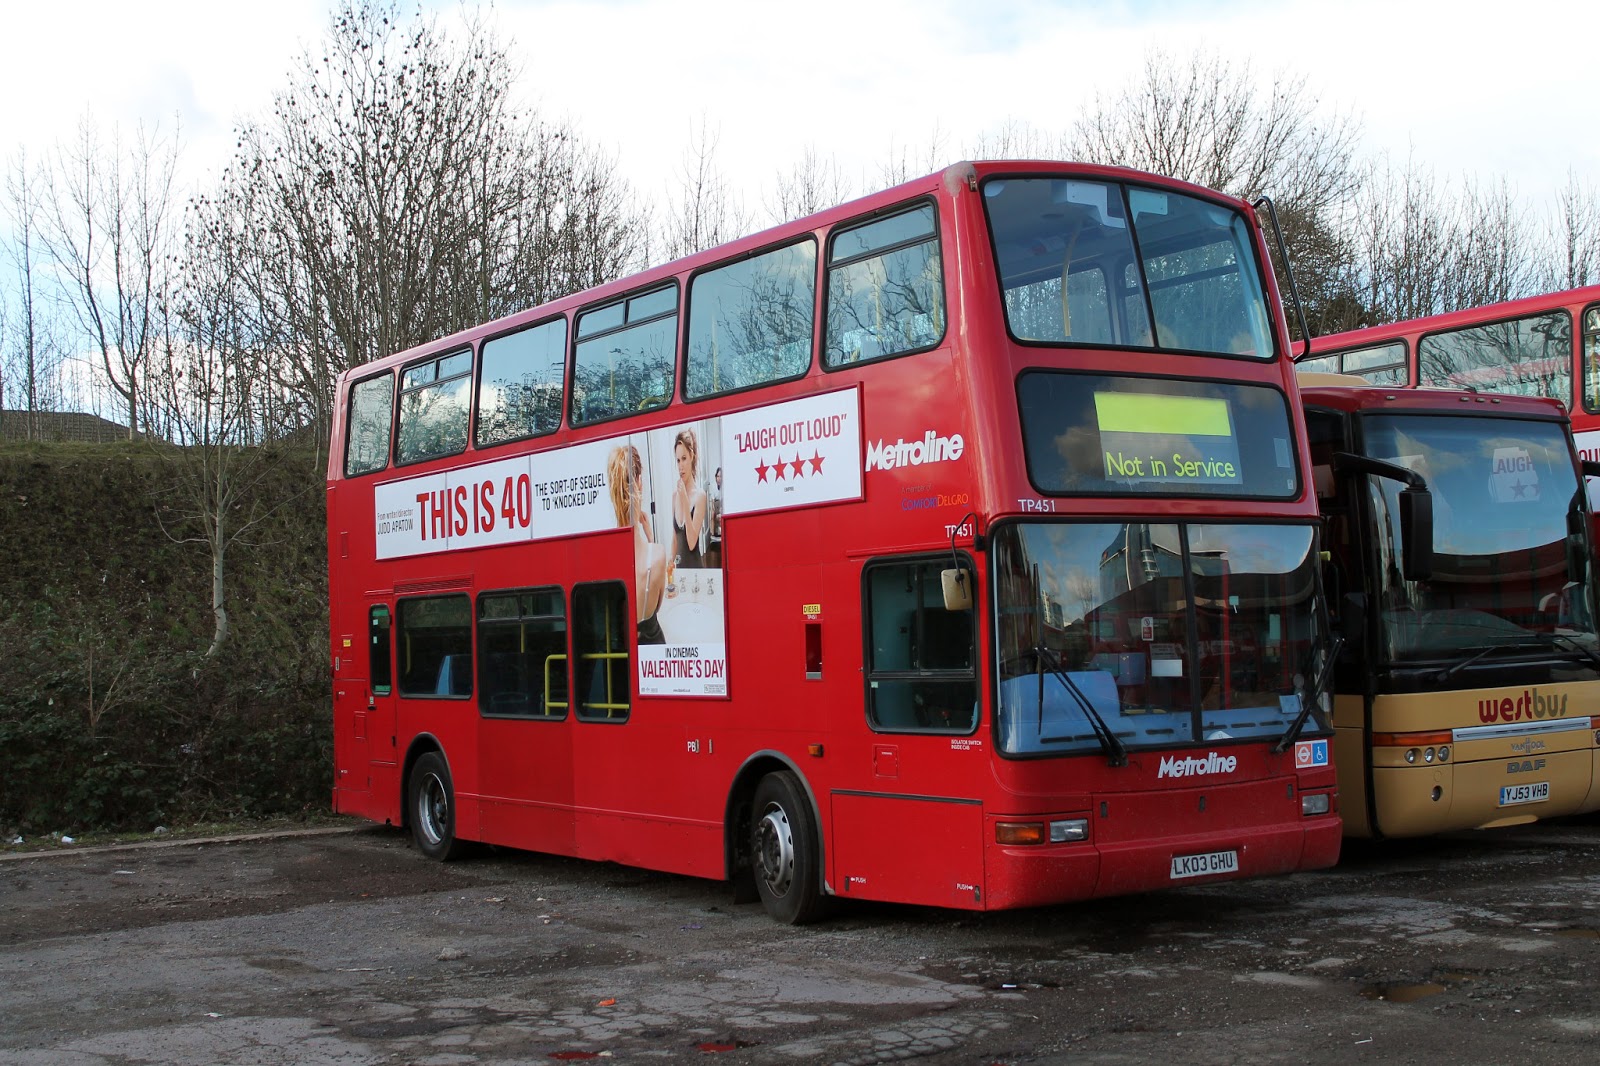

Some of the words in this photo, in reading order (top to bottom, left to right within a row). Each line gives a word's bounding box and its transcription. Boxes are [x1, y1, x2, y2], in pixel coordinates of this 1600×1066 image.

[780, 421, 805, 446] OUT
[865, 430, 964, 472] Metroline
[1105, 451, 1144, 476] Not
[1150, 455, 1167, 477] in
[1172, 453, 1236, 478] Service
[535, 482, 548, 497] THE
[550, 477, 578, 495] SORT-OF
[580, 473, 606, 490] SEQUEL
[416, 485, 468, 541] THIS
[473, 480, 496, 534] IS
[501, 473, 532, 529] 40
[542, 497, 551, 511] TO
[1018, 499, 1056, 512] TP451
[391, 519, 414, 533] APATOW
[804, 605, 820, 613] DIESEL
[665, 648, 672, 658] IN
[673, 647, 699, 658] CINEMAS
[641, 659, 702, 678] VALENTINE'S
[704, 659, 724, 678] DAY
[1479, 688, 1567, 723] westbus
[1157, 751, 1237, 779] Metroline
[1507, 759, 1546, 774] DAF
[1506, 786, 1530, 801] YJ53
[1532, 783, 1548, 798] VHB
[1210, 853, 1233, 871] GHU
[855, 876, 867, 884] PUSH
